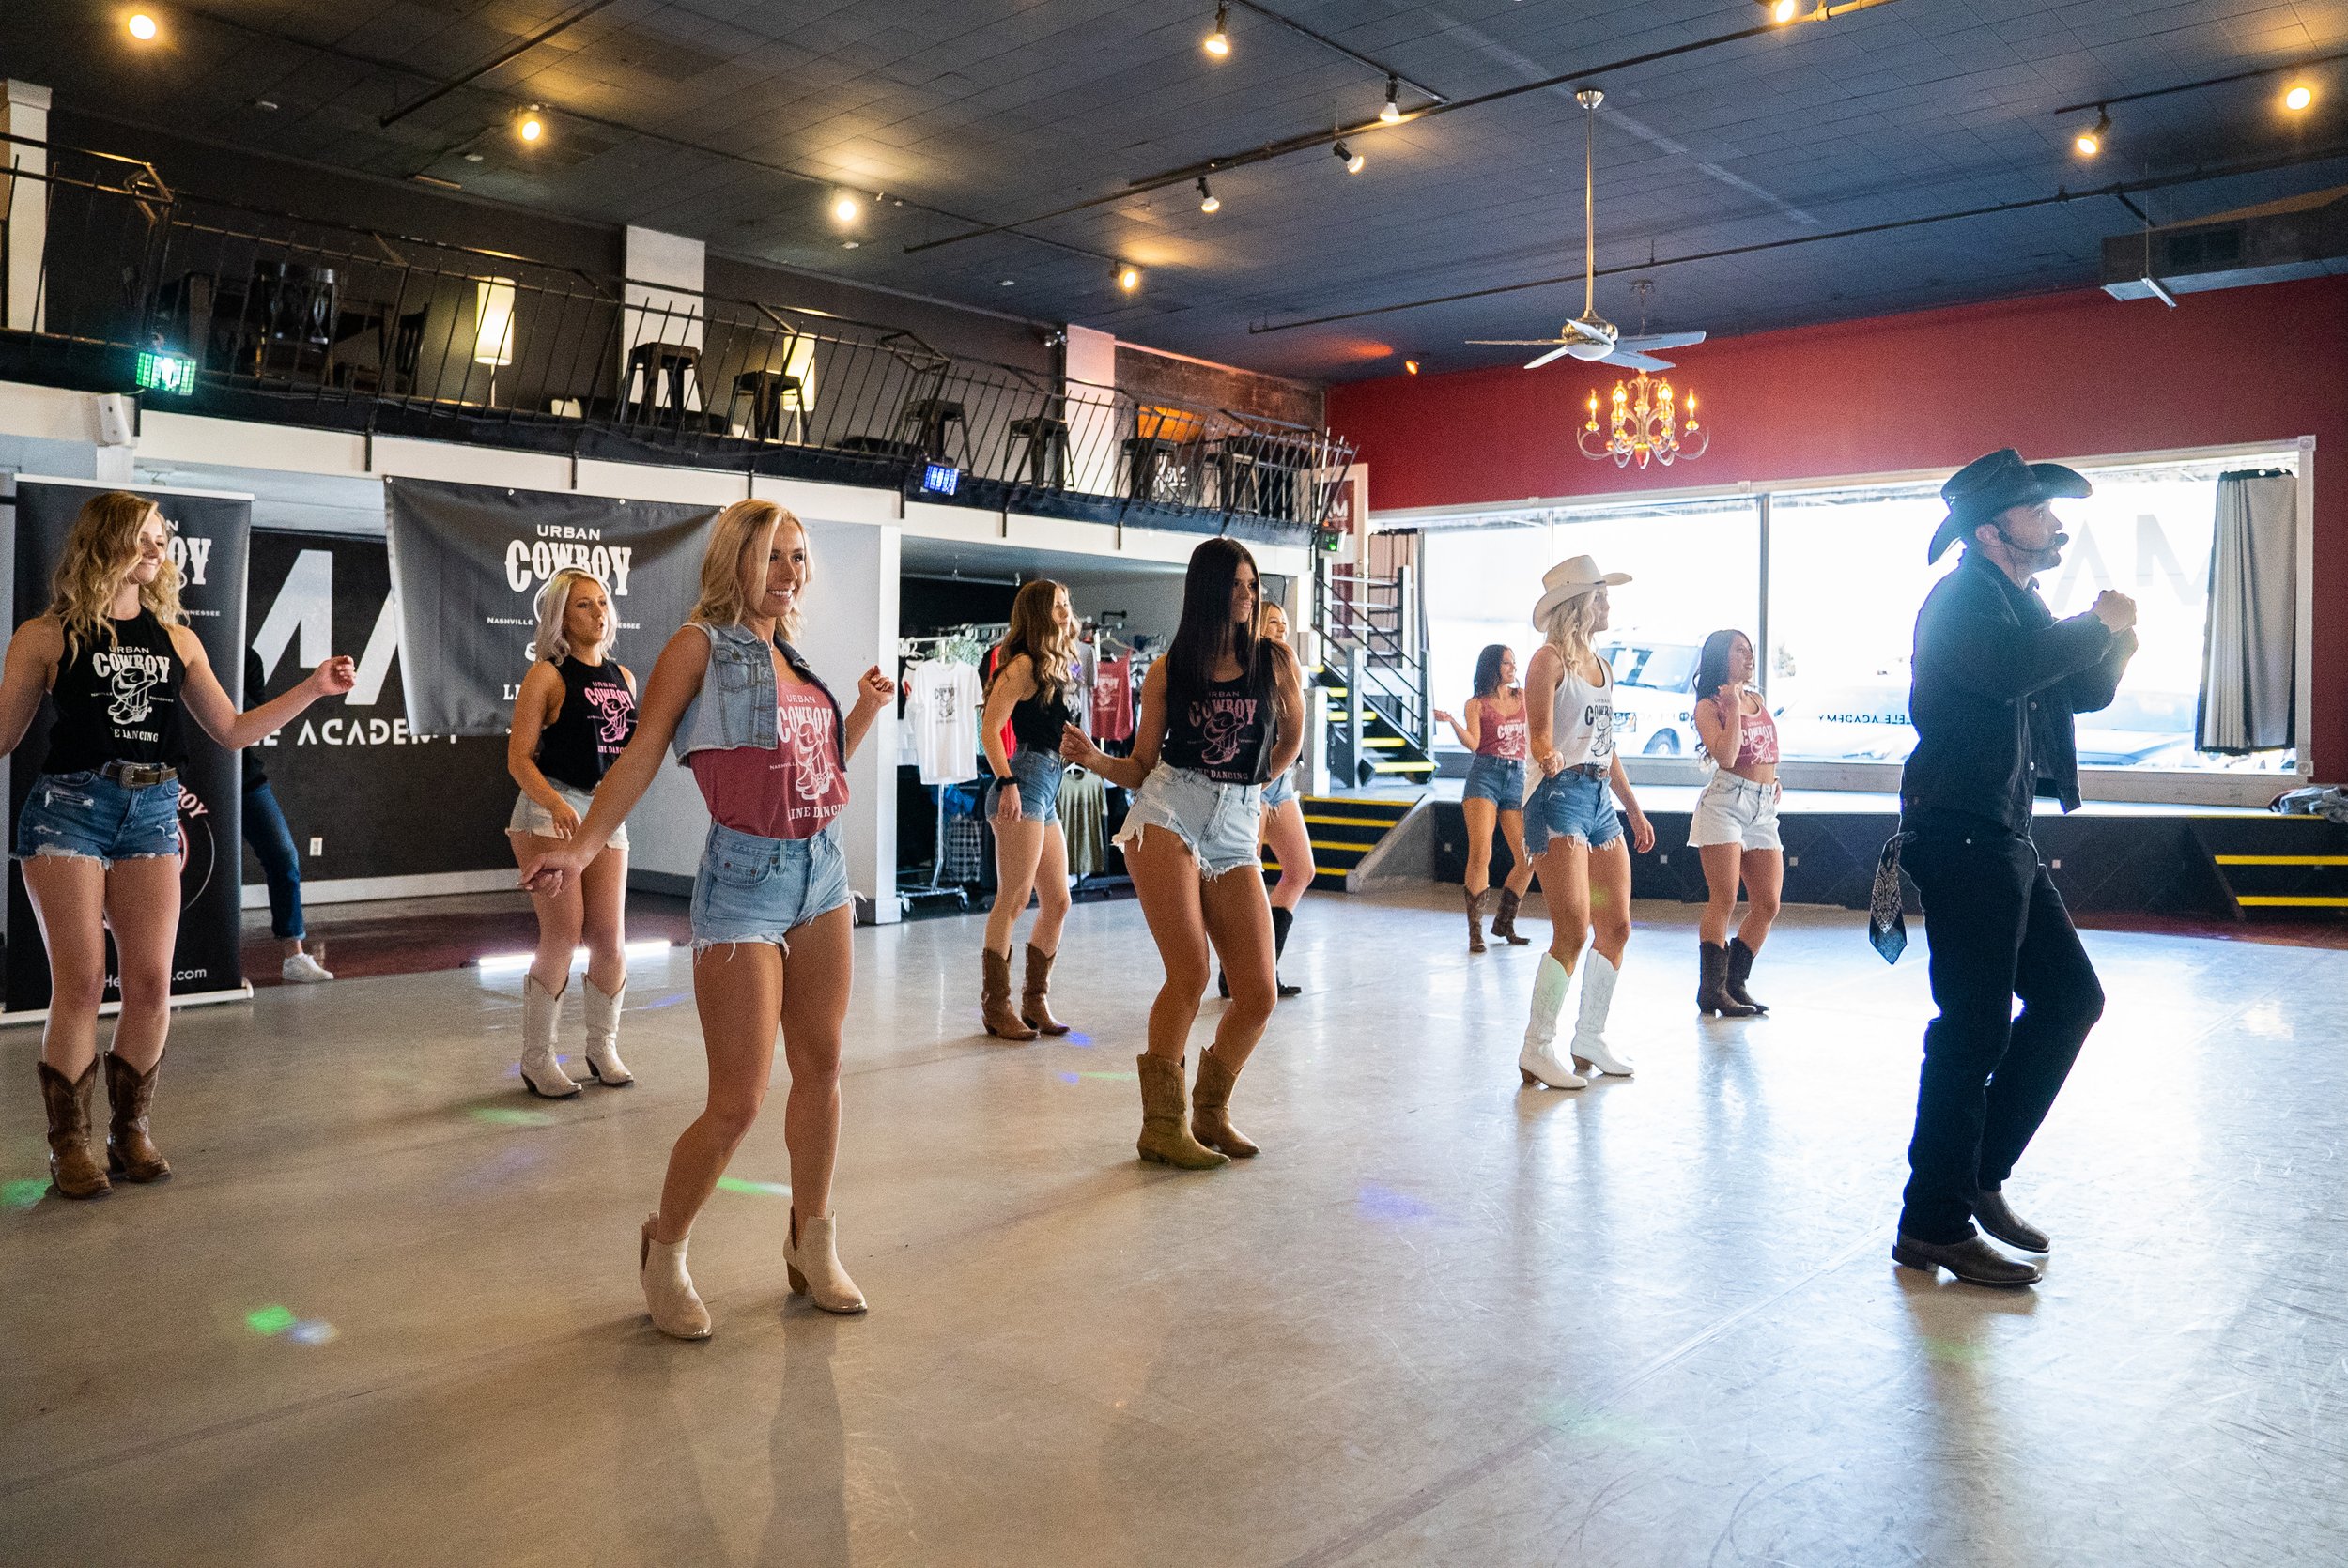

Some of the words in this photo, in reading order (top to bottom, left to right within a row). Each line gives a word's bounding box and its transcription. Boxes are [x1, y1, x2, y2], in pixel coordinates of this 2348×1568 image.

[536, 524, 601, 541] URBAN
[504, 539, 632, 596] COWBOY
[487, 616, 533, 626] NASHVILLE
[92, 652, 170, 684] COWBOY
[584, 686, 636, 710] COWBOY
[786, 694, 816, 704] URBAN
[776, 705, 833, 744] COWBOY
[1188, 698, 1258, 728] COWBOY
[297, 717, 456, 746] ACADE
[1211, 769, 1249, 780] DANCING
